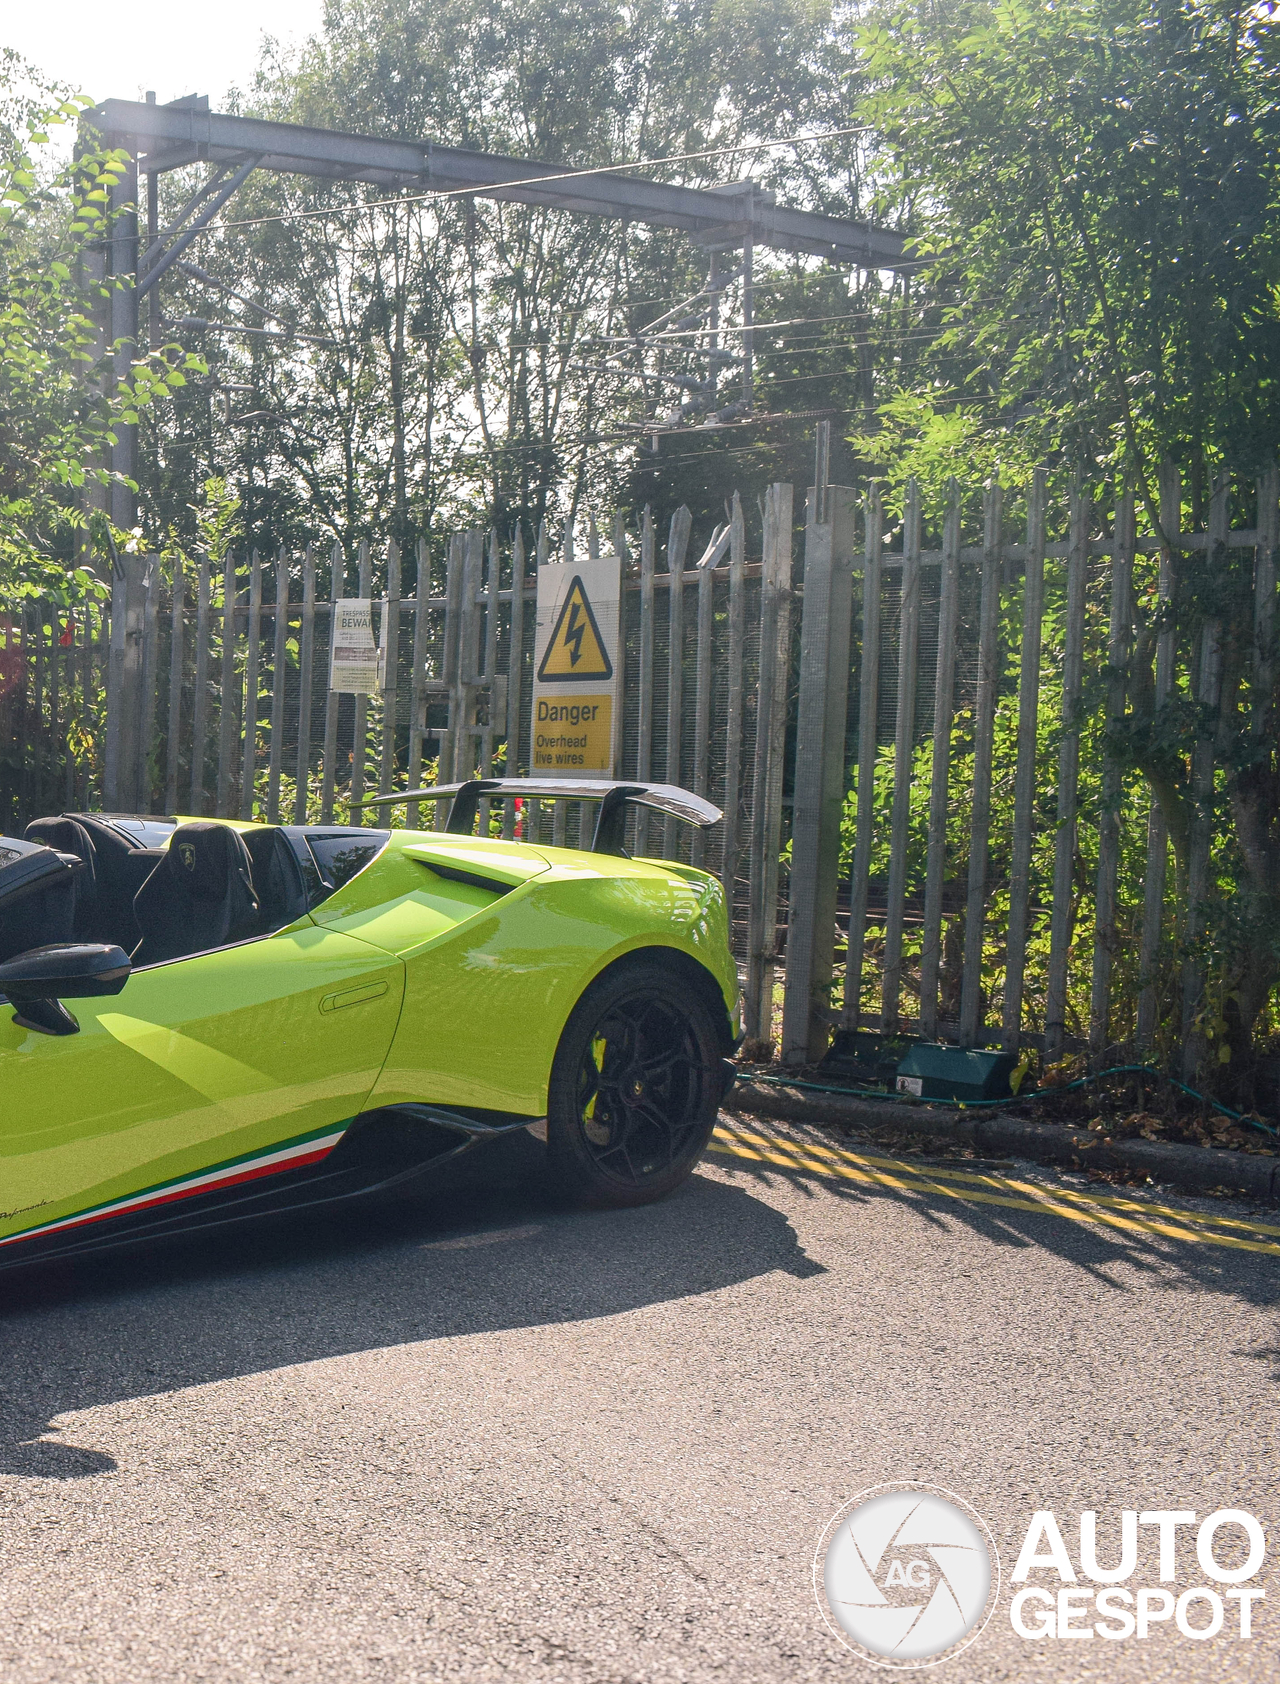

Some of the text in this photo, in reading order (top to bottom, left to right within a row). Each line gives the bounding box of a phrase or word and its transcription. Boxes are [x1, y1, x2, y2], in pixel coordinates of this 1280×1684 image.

[538, 701, 599, 726] Danger
[536, 734, 587, 748] Overhead
[535, 751, 585, 765] live wires
